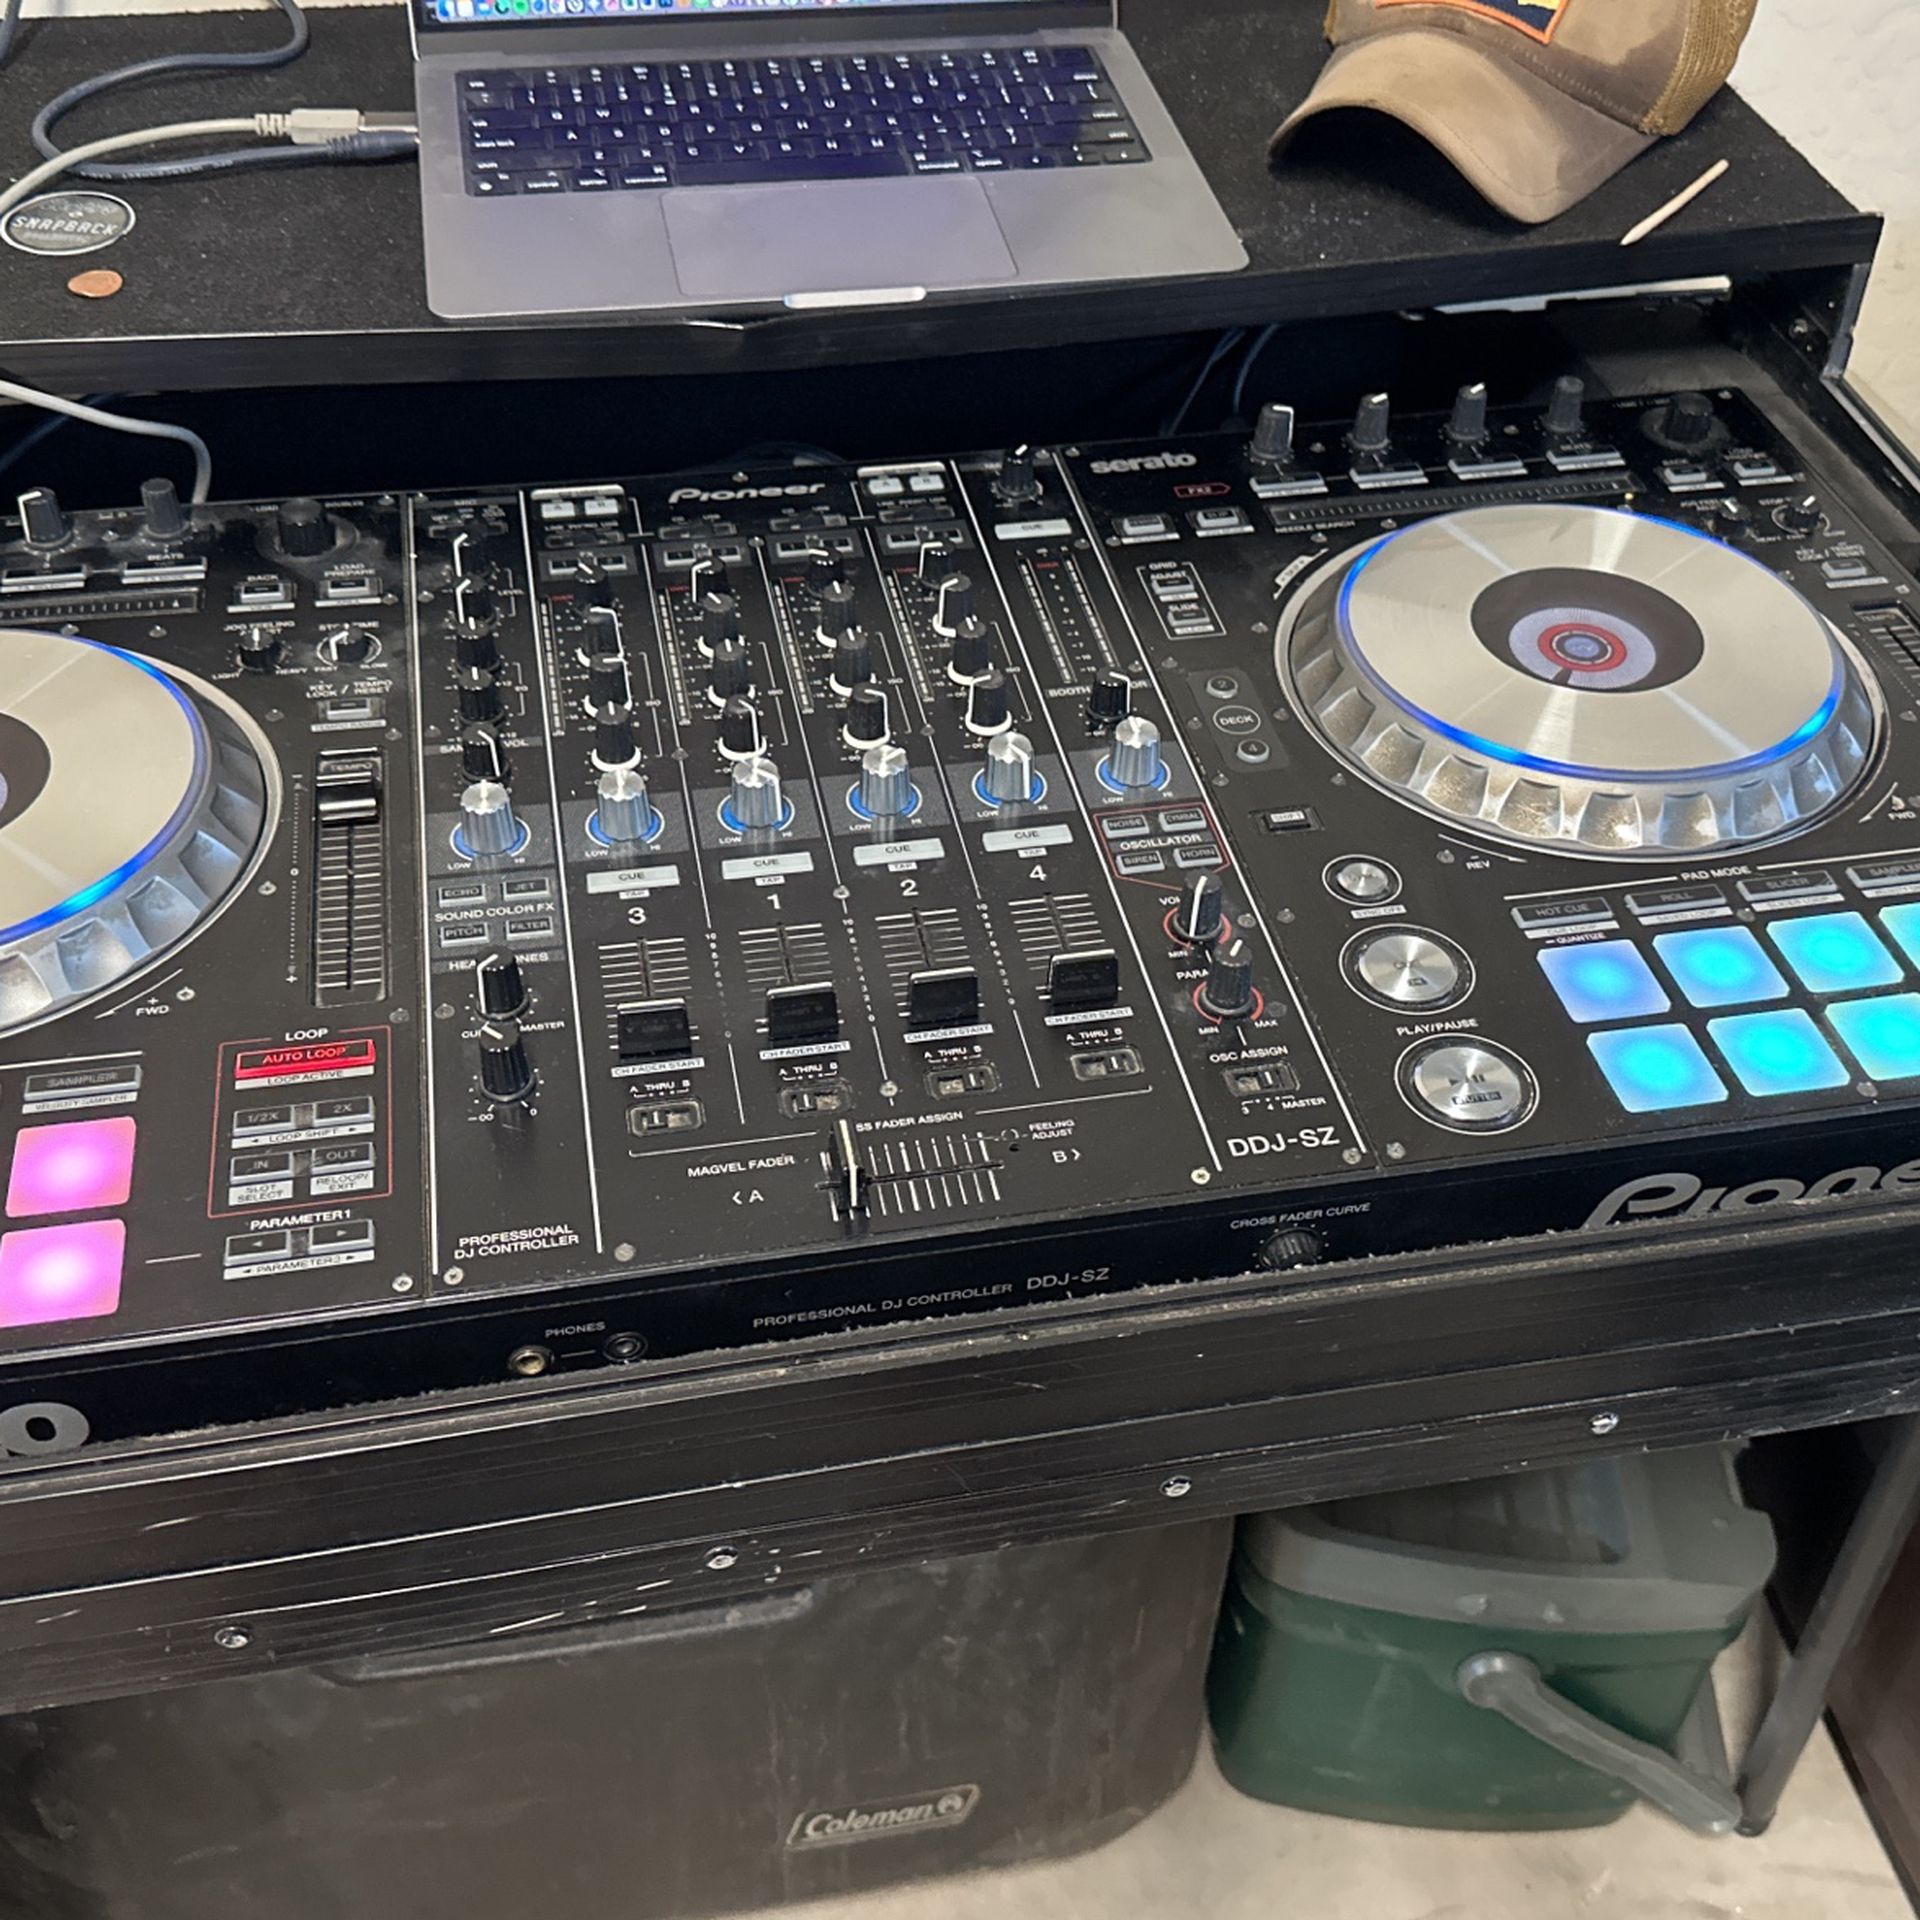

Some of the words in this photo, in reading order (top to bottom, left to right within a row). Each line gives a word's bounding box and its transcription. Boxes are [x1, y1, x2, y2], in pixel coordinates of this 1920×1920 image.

[11, 216, 118, 236] SNAPBACK
[1090, 452, 1197, 474] serato
[668, 483, 826, 504] Pioneer
[1220, 715, 1254, 725] DECK
[1108, 818, 1143, 829] NOISE
[885, 844, 911, 854] CUE
[1119, 834, 1204, 851] OSCILLATOR
[753, 857, 780, 867] CUE
[1465, 860, 1492, 870] REV
[618, 871, 646, 882] CUE
[1029, 864, 1047, 881] 4
[1680, 870, 1710, 881] PAD
[1712, 865, 1751, 878] MODE
[444, 885, 480, 898] ECHO
[514, 881, 536, 892] JET
[900, 879, 919, 897] 2
[766, 893, 781, 910] 1
[434, 909, 484, 922] SOUND
[486, 904, 534, 918] COLOR
[536, 902, 555, 914] FX
[627, 907, 646, 925] 3
[1536, 906, 1562, 917] HOT
[1564, 903, 1591, 913] CUE
[445, 925, 484, 938] PITCH
[1557, 932, 1607, 945] QUANTIZE
[136, 1005, 170, 1017] FWD
[520, 1020, 565, 1032] MASTER
[1396, 1018, 1479, 1037] PLAY/PAUSE
[285, 1028, 329, 1041] LOOP
[262, 1050, 303, 1064] AUTO
[306, 1046, 346, 1060] LOOP
[938, 1047, 967, 1056] THRU
[1209, 1052, 1239, 1063] OSC
[1241, 1045, 1289, 1060] ASSIGN
[793, 1064, 823, 1074] THRU
[646, 1080, 675, 1090] THRU
[333, 1103, 352, 1114] 2X
[1281, 1097, 1327, 1110] MASTER
[247, 1112, 280, 1123] 1/2X
[874, 1116, 915, 1131] FADER
[917, 1111, 963, 1125] ASSIGN
[1032, 1128, 1075, 1140] ADJUST
[1226, 1127, 1341, 1158] DDJ-SZ
[326, 1149, 357, 1161] OUT
[253, 1160, 270, 1170] IN
[687, 1163, 746, 1178] MAGVEL
[749, 1154, 796, 1169] FADER
[1230, 1214, 1276, 1230] CROSS
[1279, 1208, 1323, 1224] FADER
[1325, 1203, 1371, 1218] CURVE
[459, 1224, 574, 1248] PROFESSIONAL
[454, 1246, 475, 1260] DJ
[479, 1234, 580, 1255] CONTROLLER
[753, 1301, 877, 1328] PROFESSIONAL
[881, 1298, 903, 1311] DJ
[907, 1282, 1013, 1307] CONTROLLER
[1026, 1267, 1111, 1290] DDJ-SZ
[545, 1321, 606, 1339] PHONES
[804, 1802, 935, 1838] Coleman
